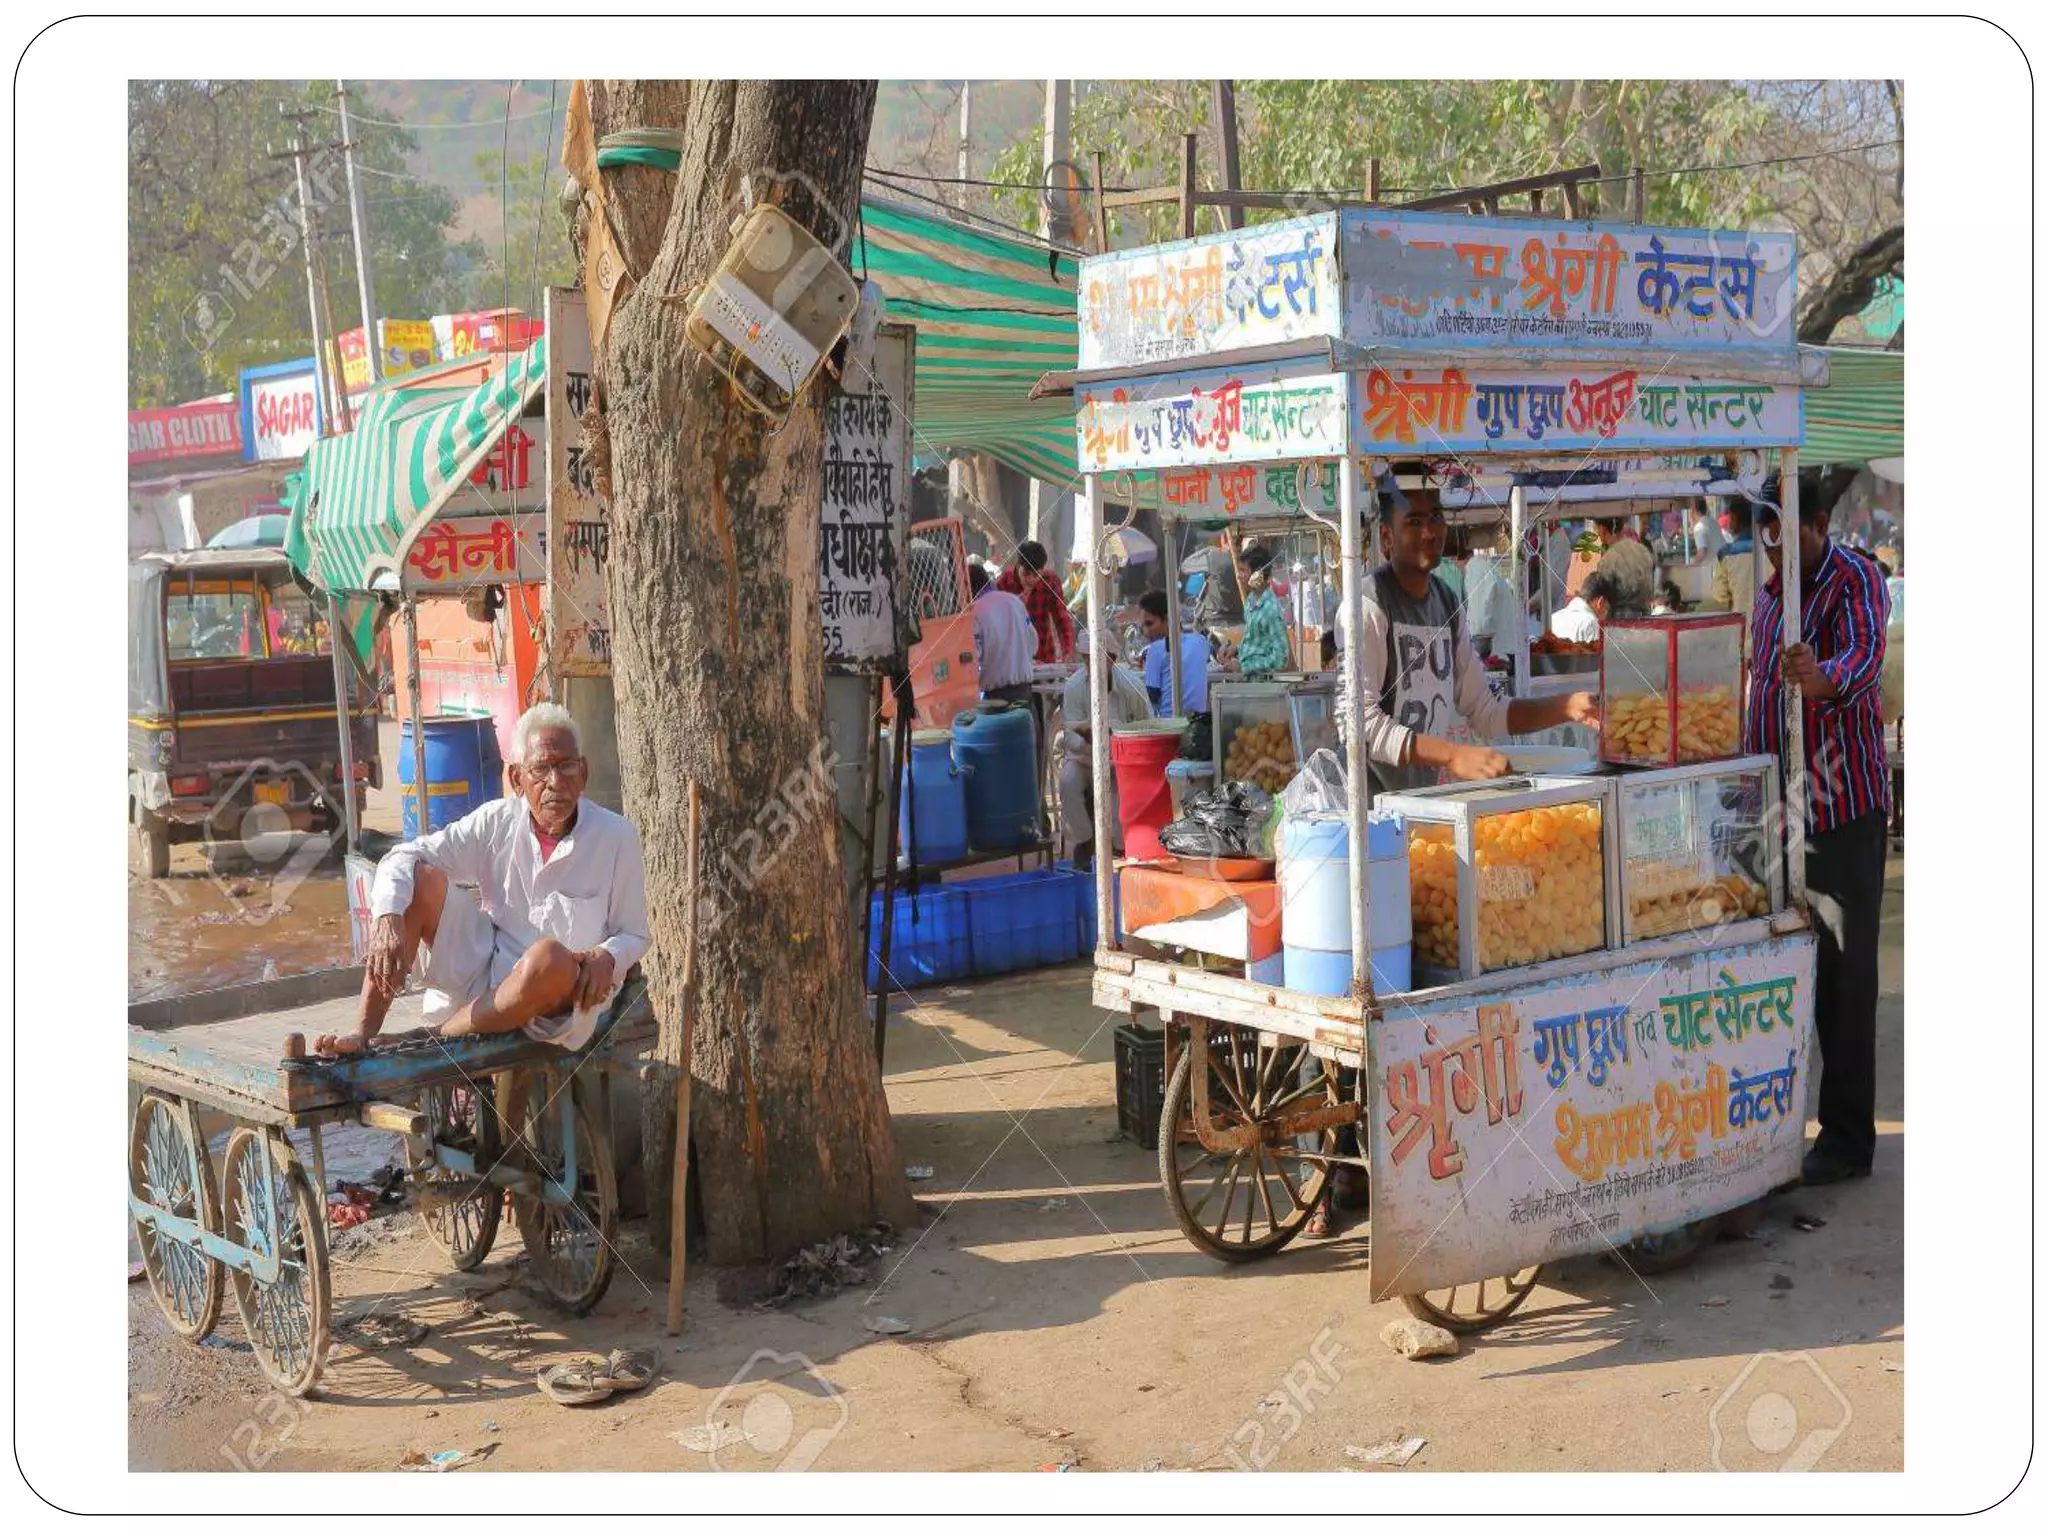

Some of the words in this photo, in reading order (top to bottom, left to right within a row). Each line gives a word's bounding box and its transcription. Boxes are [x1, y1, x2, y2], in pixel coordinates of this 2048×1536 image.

[168, 412, 232, 448] CLOTH
[258, 391, 315, 438] SAGAR
[1476, 384, 1524, 439] गुप
[1566, 370, 1639, 439] अनुज
[1637, 384, 1681, 430] चाट
[1163, 465, 1212, 507] पानी
[1218, 464, 1256, 514] पुरी
[408, 520, 526, 580] सैनी
[820, 510, 897, 584] धीक्षक
[822, 625, 843, 653] 55
[1533, 1013, 1583, 1090] गुप
[1658, 990, 1712, 1052] चाट
[1712, 969, 1797, 1043] सेन्टर
[1728, 1046, 1798, 1130] केटर्स
